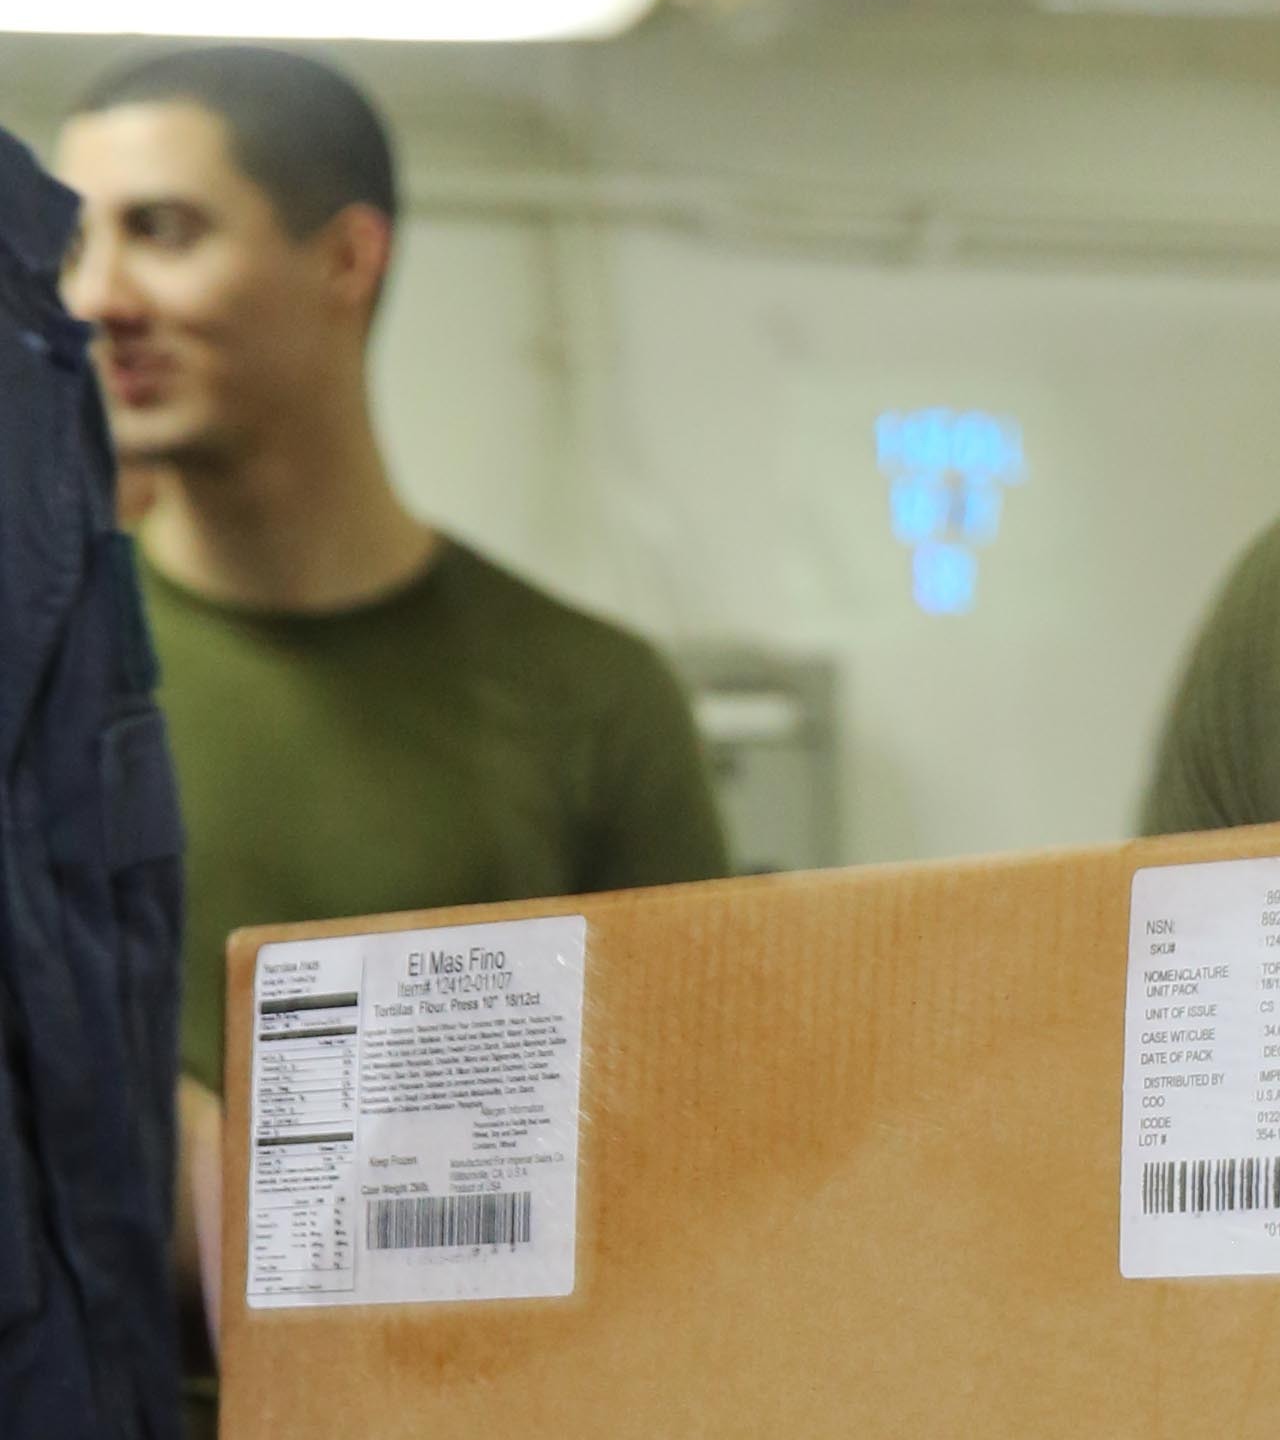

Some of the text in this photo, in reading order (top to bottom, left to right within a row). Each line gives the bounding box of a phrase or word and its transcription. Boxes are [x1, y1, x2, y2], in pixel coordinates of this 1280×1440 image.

[408, 947, 505, 976] El Mas Fino
[1144, 965, 1229, 983] NOMENCLATURE
[397, 981, 430, 998] Item#
[1146, 982, 1199, 998] UNIT PACK
[374, 1002, 413, 1017] Tortillas
[451, 997, 479, 1011] Press
[1145, 1004, 1217, 1021] UNIT OF ISSUE
[1259, 1000, 1275, 1014] CS
[1141, 1031, 1168, 1045] CASE
[1141, 1049, 1214, 1066] DATE OF PACK
[1143, 1072, 1225, 1090] DISTRIBUTED BY
[1142, 1095, 1165, 1109] COO
[1139, 1133, 1159, 1147] LOT
